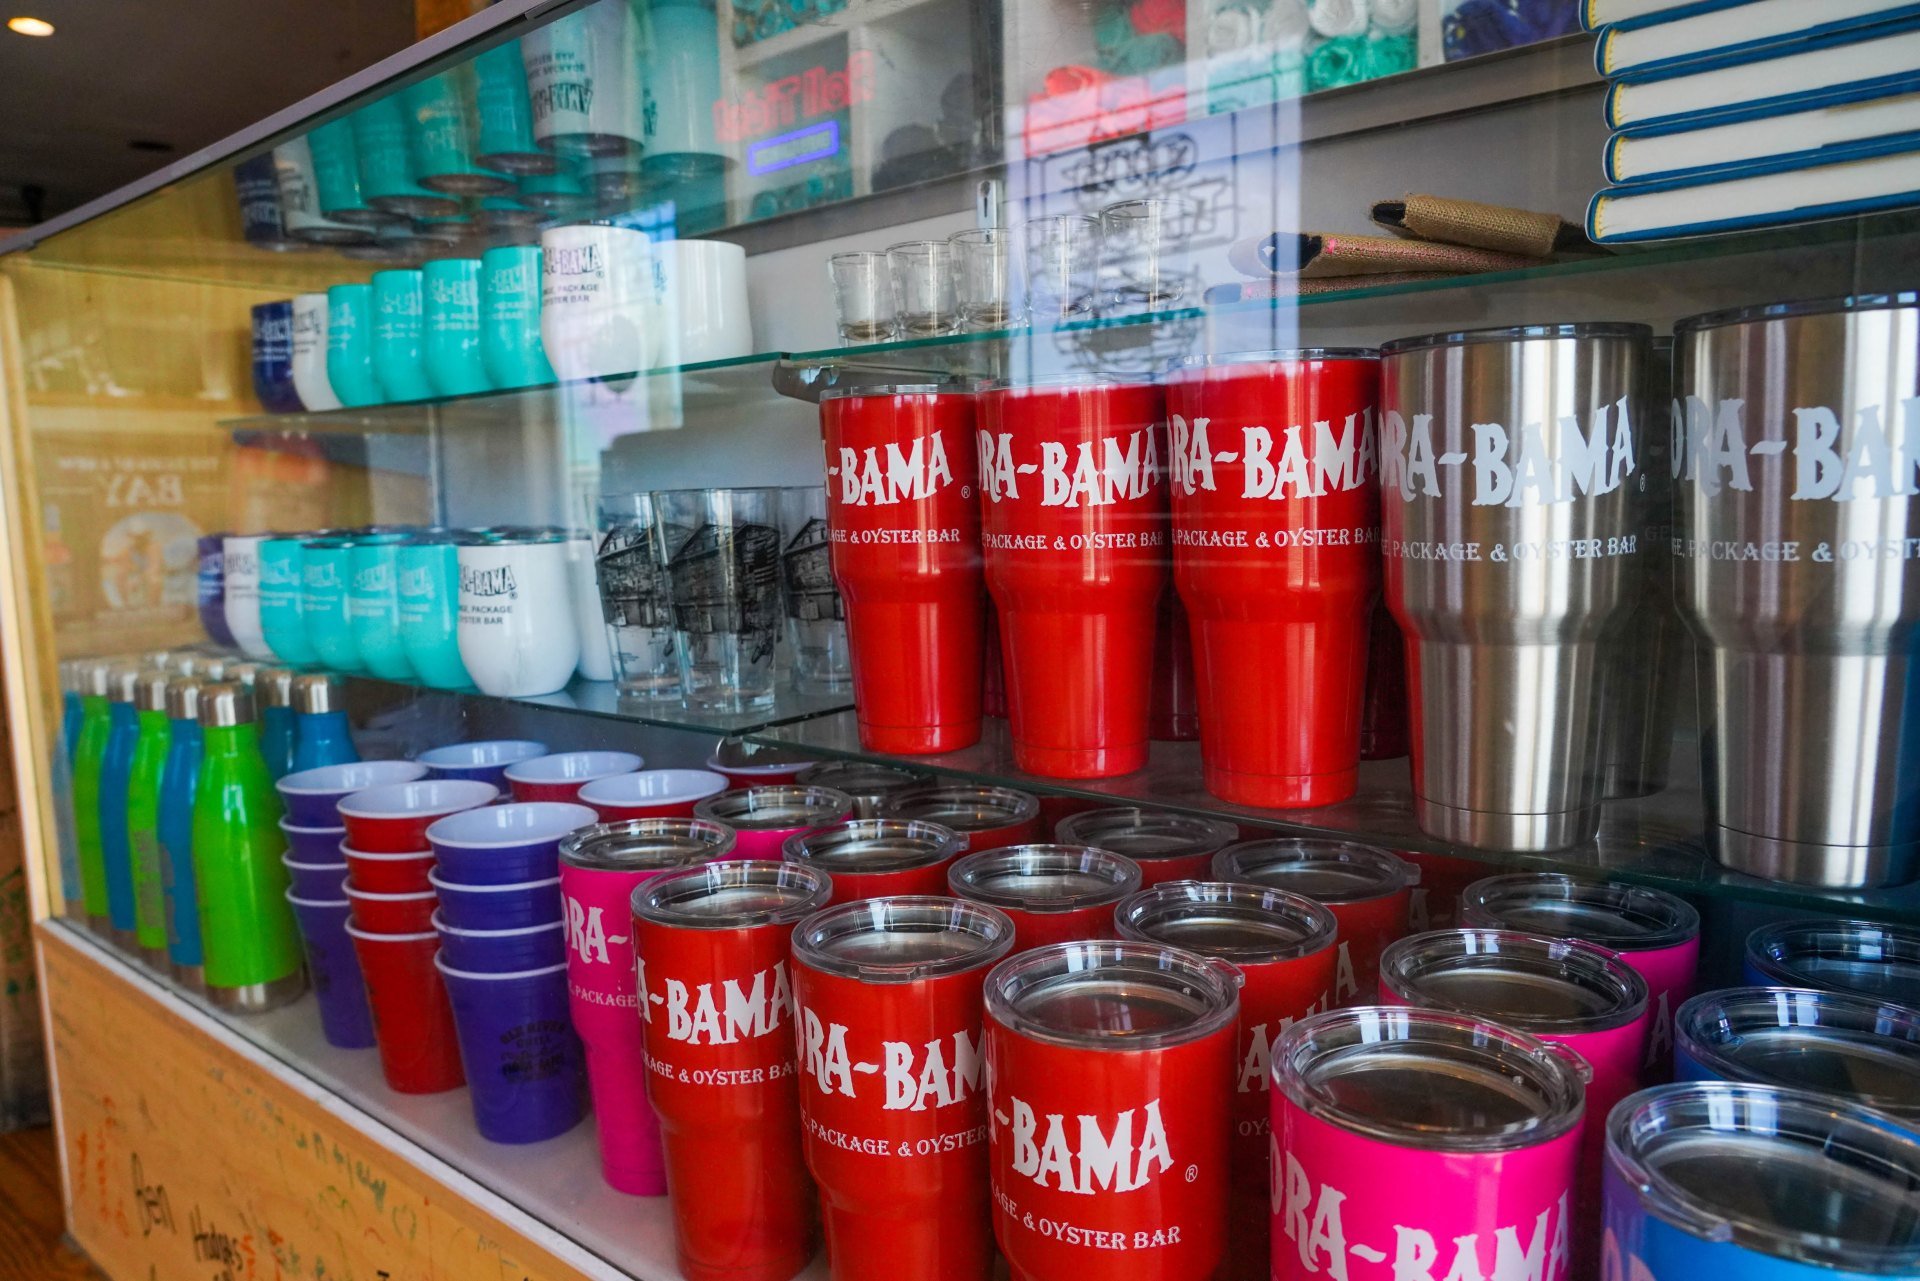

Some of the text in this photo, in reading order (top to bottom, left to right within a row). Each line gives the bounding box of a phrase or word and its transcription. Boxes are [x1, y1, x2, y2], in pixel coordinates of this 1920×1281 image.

[823, 430, 953, 506] -BAMA
[977, 424, 1160, 507] RA-BAMA
[851, 532, 860, 544] &
[862, 528, 922, 544] OYSTER
[927, 528, 960, 543] BAR
[986, 535, 1046, 551] PACKAGE
[1054, 536, 1067, 550] &
[1070, 532, 1136, 550] OYSTER
[1177, 529, 1248, 547] PACKAGE
[1256, 532, 1270, 548] &
[1274, 527, 1350, 547] OYSTER
[1393, 541, 1482, 561] PACKAGE
[1490, 543, 1508, 562] &
[1513, 538, 1603, 560] OYSTER
[1608, 534, 1637, 555] BAR
[1688, 539, 1801, 562] PACKAGE
[1811, 542, 1834, 562] &
[1840, 537, 1920, 560] OYST
[471, 604, 513, 614] PACKAGE
[484, 616, 503, 625] BAR
[575, 988, 638, 1008] PACKAGE
[679, 1072, 690, 1084] &
[693, 1067, 764, 1086] OYSTER
[811, 1118, 891, 1156] PACKAGE
[898, 1141, 913, 1157] &
[917, 1124, 987, 1154] OYSTER
[1023, 1212, 1036, 1232] &
[1039, 1218, 1127, 1250] OYSTER
[1133, 1226, 1181, 1250] BAR
